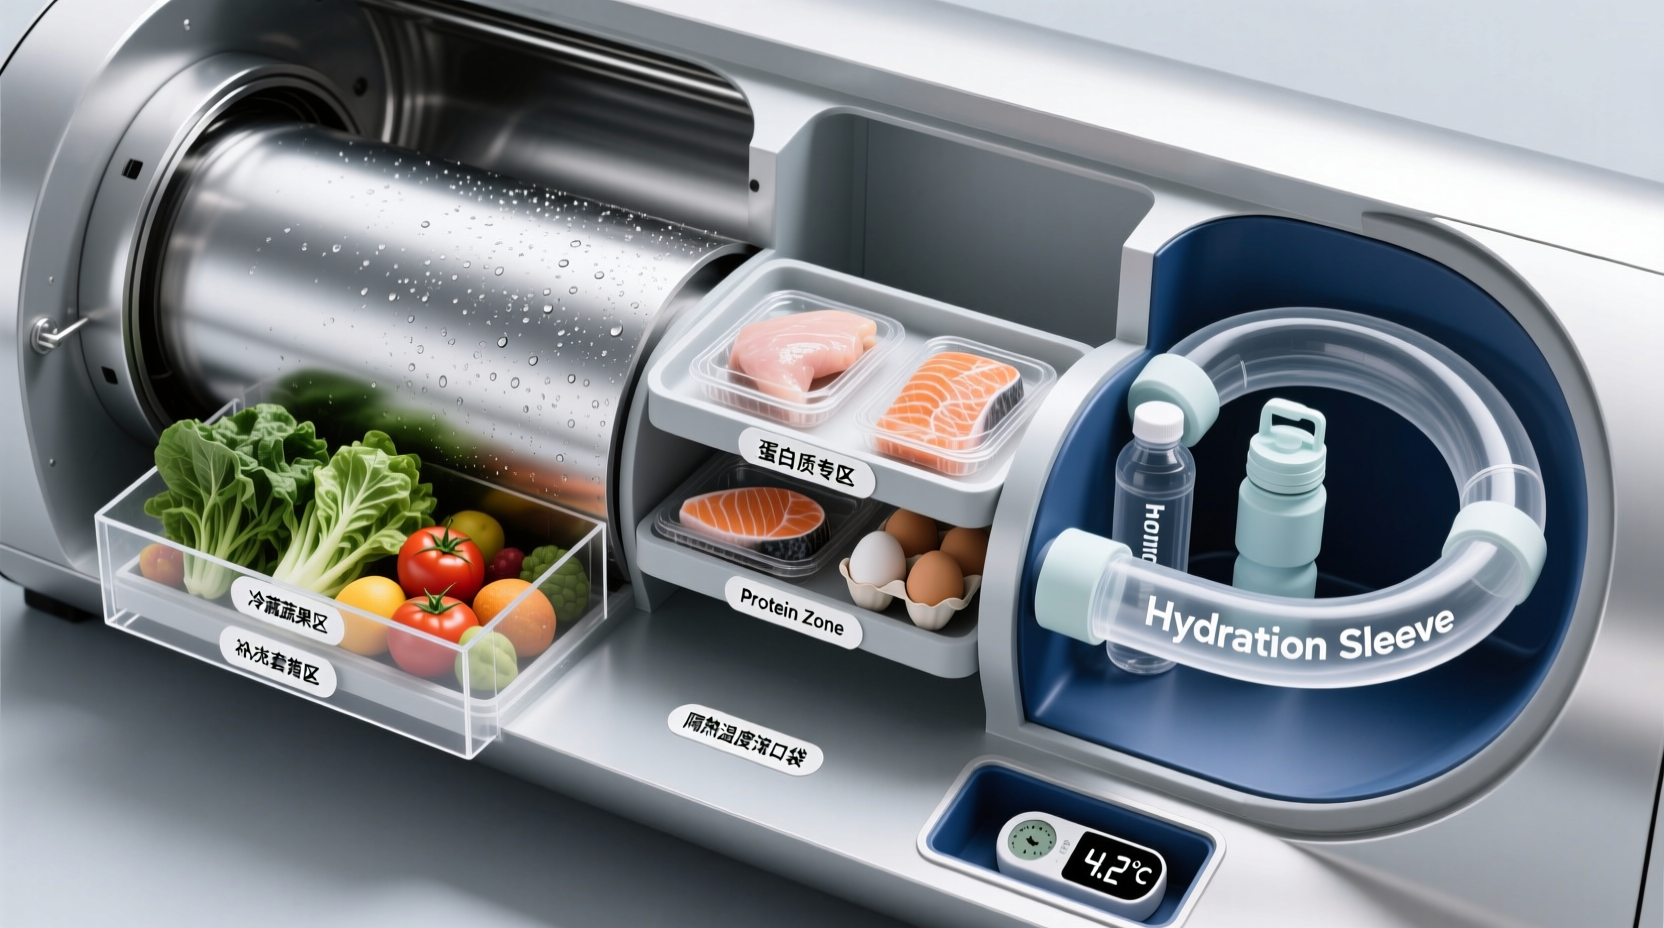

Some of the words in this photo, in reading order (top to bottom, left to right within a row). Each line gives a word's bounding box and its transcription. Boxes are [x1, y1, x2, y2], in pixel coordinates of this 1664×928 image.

[758, 438, 855, 487] 蛋白质专区
[740, 587, 798, 621] Protein
[802, 608, 844, 636] Zone
[1145, 595, 1327, 661] Hydration
[1339, 609, 1455, 659] Sleeve
[1084, 848, 1153, 886] 4.2°C
